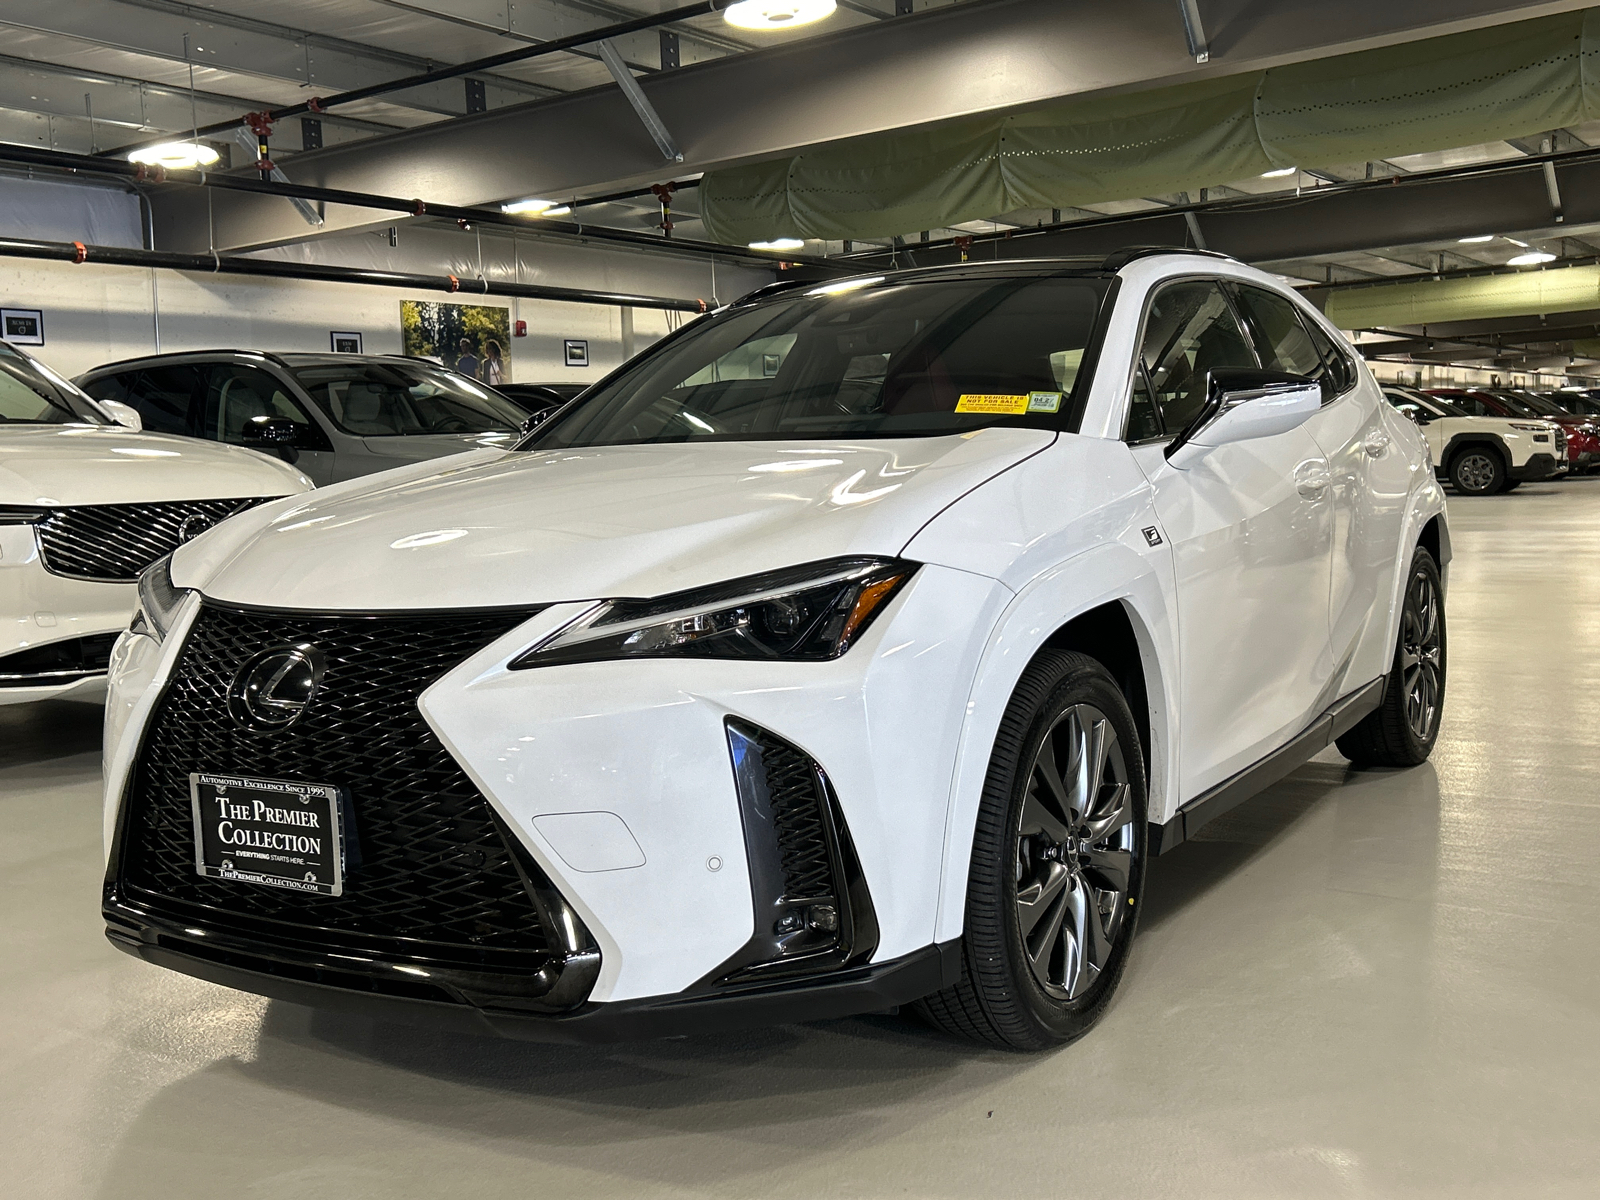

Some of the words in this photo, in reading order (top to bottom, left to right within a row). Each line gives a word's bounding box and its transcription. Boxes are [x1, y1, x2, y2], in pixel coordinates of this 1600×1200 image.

[200, 775, 243, 787] AUTOMOTIVE
[243, 779, 285, 791] EXCELLENCE
[285, 784, 306, 794] SINCE
[306, 786, 325, 796] 1995
[215, 796, 251, 820] THE
[252, 799, 320, 828] PREMIER
[217, 820, 321, 855] COLLECTION
[235, 850, 270, 860] EVERYTHING
[270, 854, 290, 863] STARTS
[218, 868, 319, 892] THEPREMIERCOLLECTION.COM
